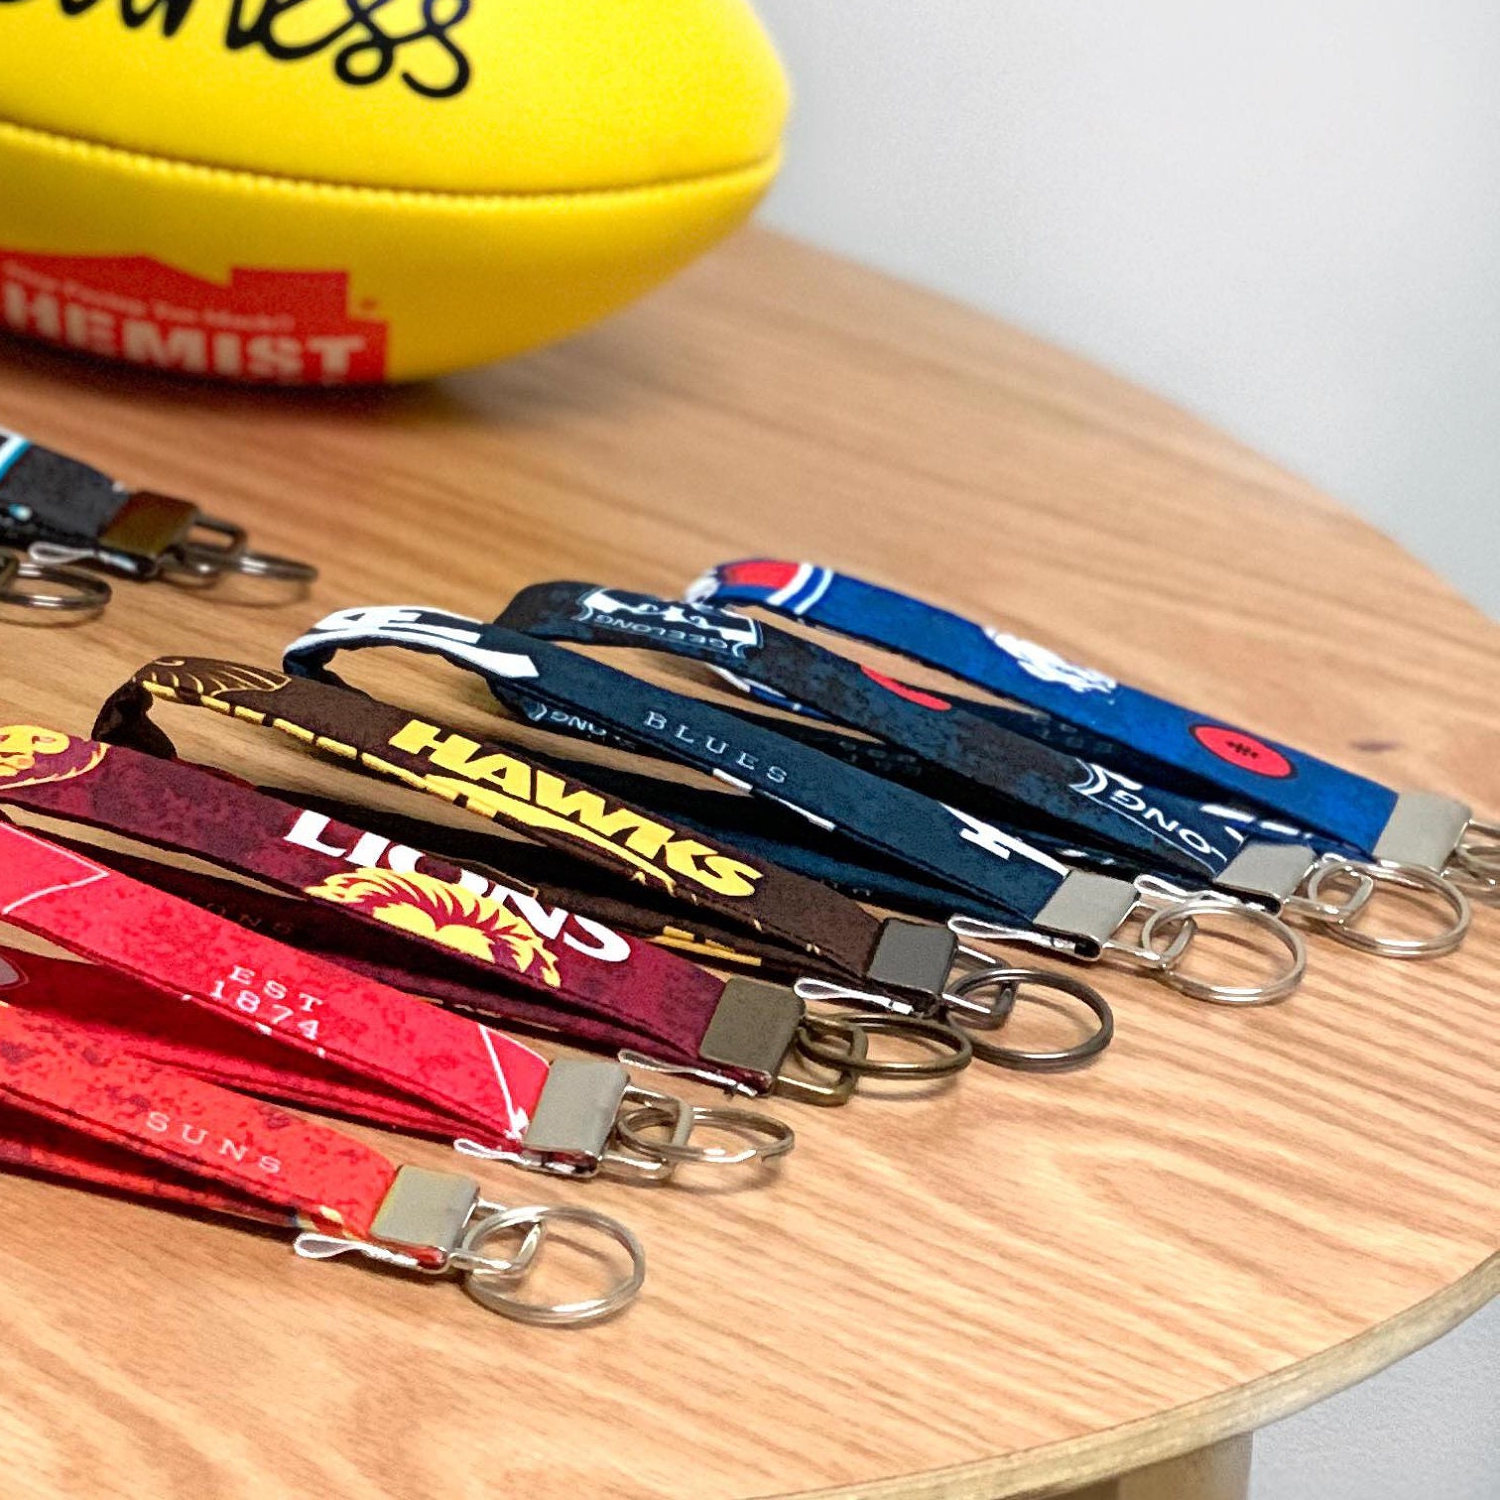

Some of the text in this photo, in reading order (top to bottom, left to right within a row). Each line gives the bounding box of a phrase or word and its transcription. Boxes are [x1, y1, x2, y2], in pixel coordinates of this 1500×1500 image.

[642, 709, 790, 785] BLUES
[387, 718, 764, 898] HAWKS
[209, 979, 320, 1041] 1874
[227, 964, 326, 1015] EST
[145, 1111, 283, 1176] SUNS
